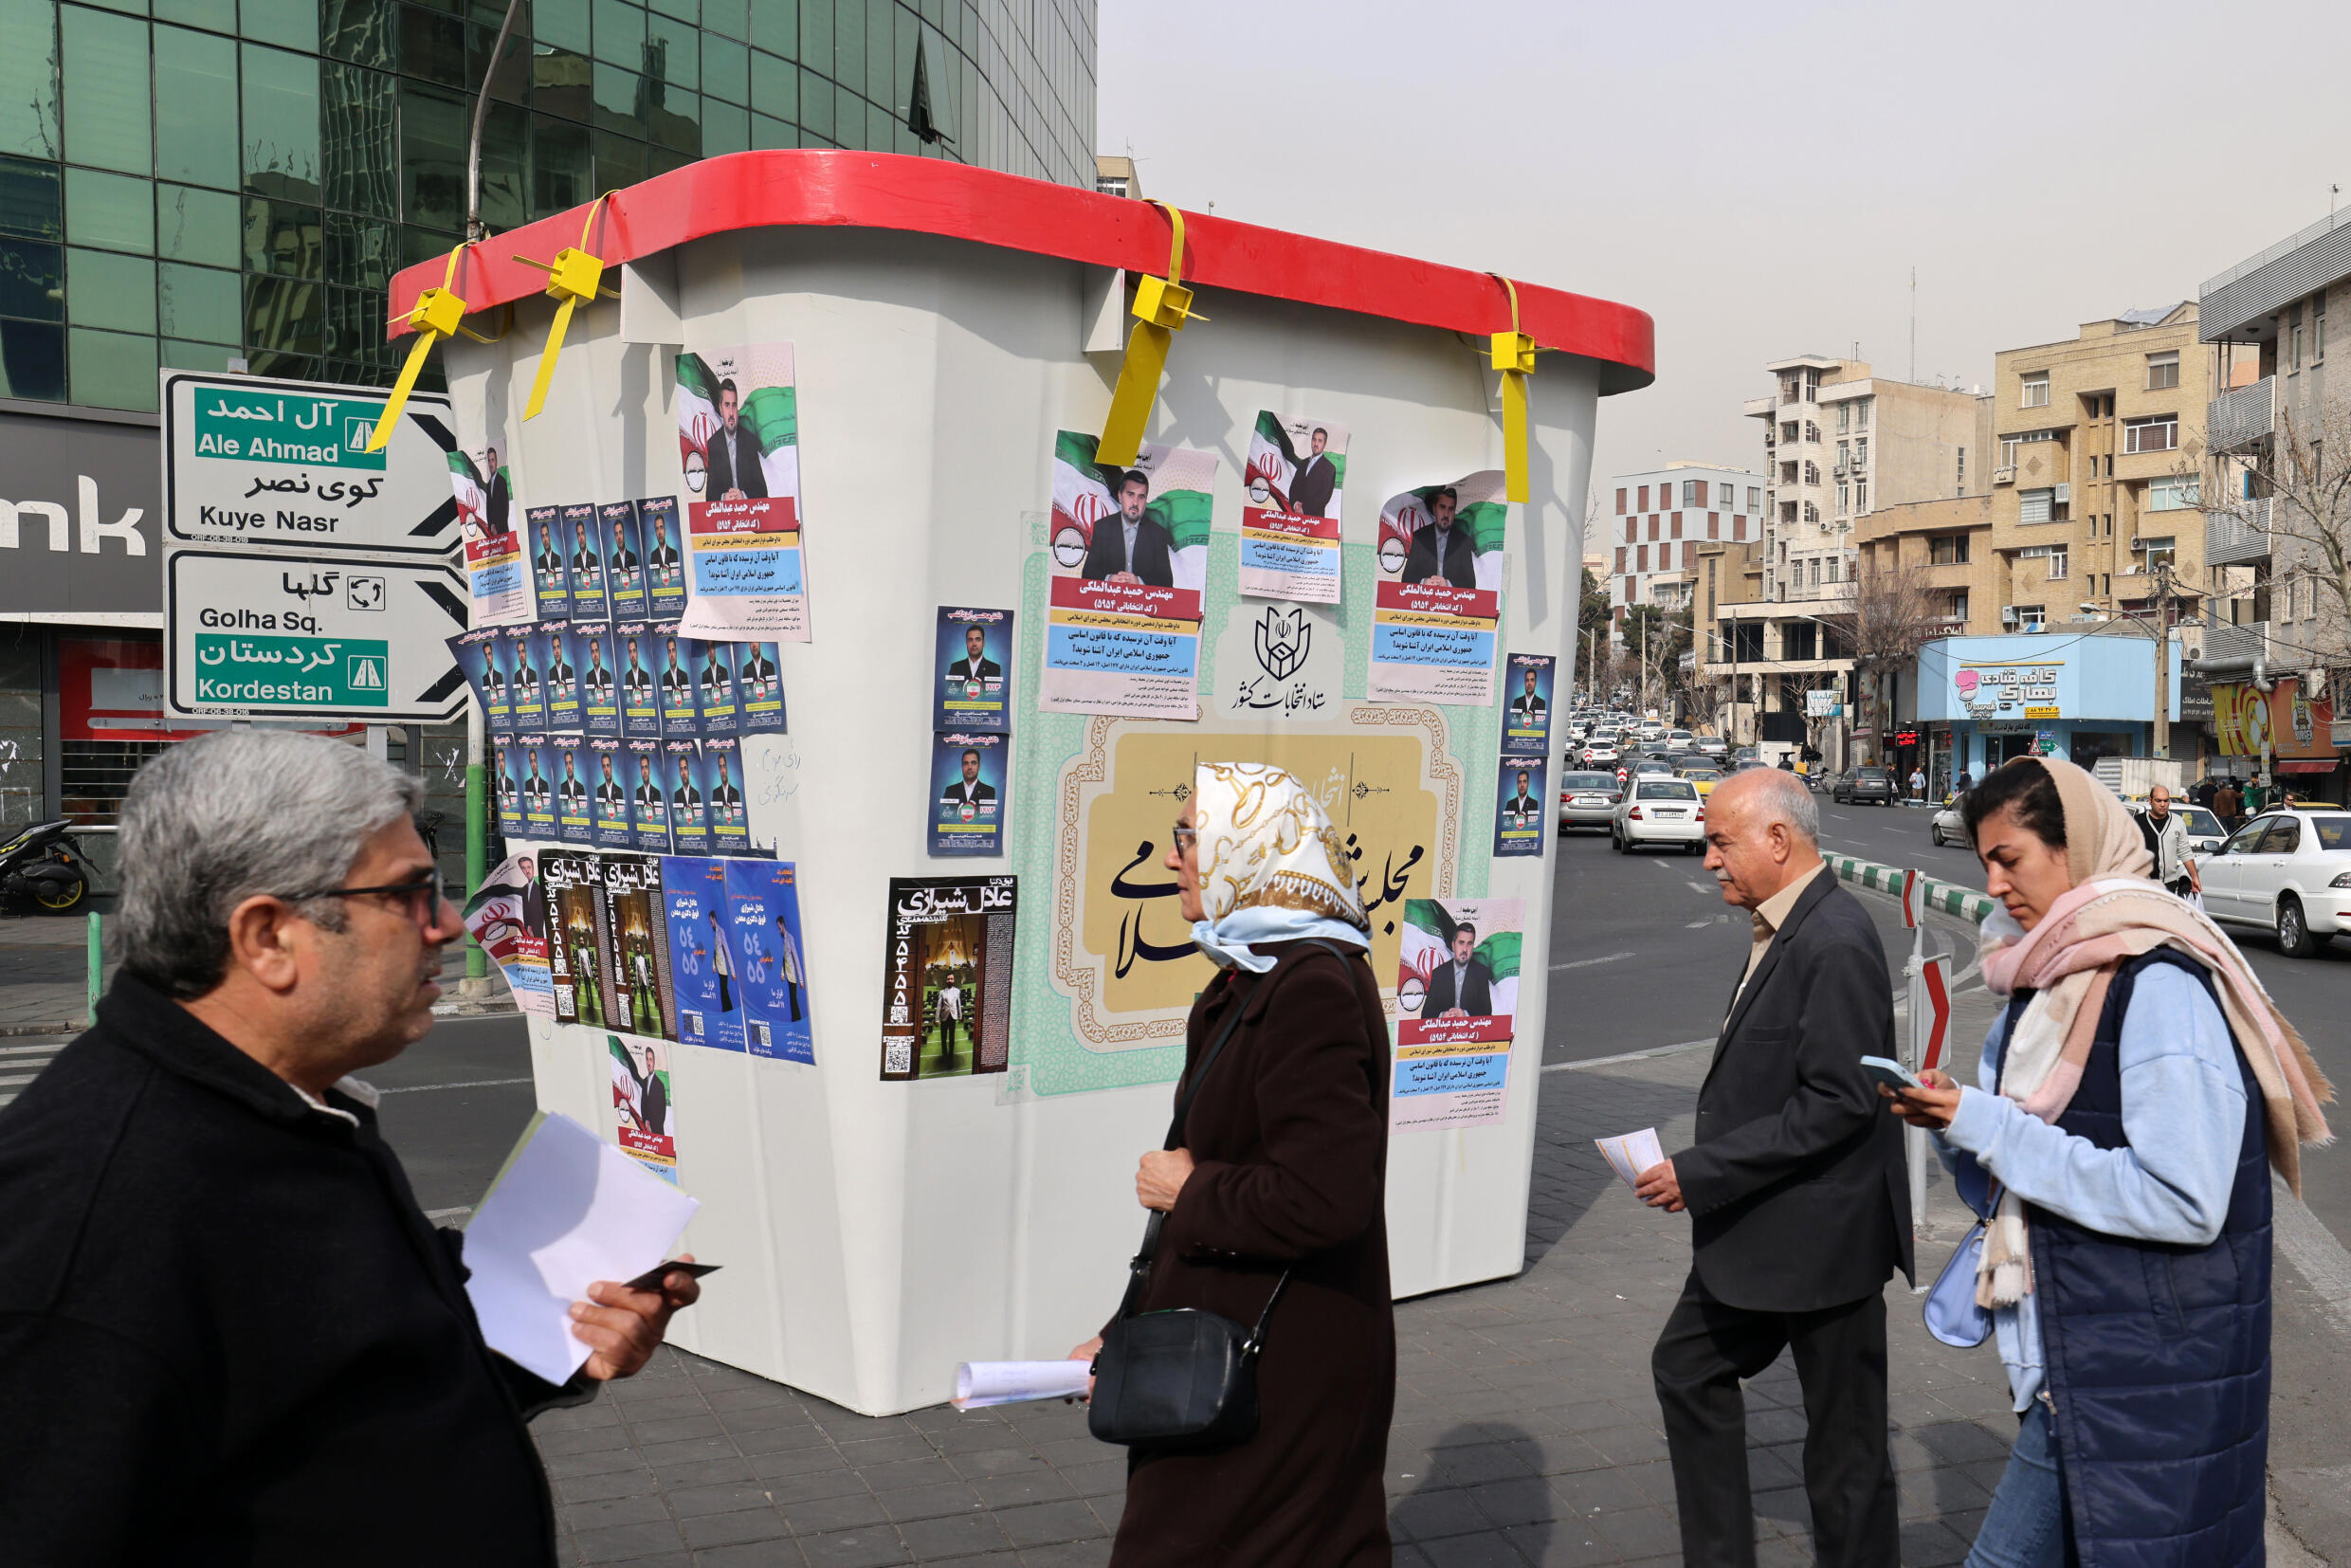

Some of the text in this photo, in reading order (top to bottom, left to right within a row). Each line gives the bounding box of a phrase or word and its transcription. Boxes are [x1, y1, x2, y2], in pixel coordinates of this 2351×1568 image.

[207, 399, 338, 429] آل احمد
[198, 433, 338, 463] Ale Ahmad
[245, 473, 384, 508] کوی نصر
[200, 505, 338, 532] Kuye Nasr
[282, 572, 339, 601] گلها
[1080, 581, 1174, 601] مهندس حمید عبدالملکی
[1399, 584, 1476, 601] مهندس حمید عبدالملکی
[199, 608, 322, 635] Golha Sq.
[1068, 629, 1088, 640] اساسی
[1089, 630, 1106, 642] قانون
[199, 640, 341, 673] کردستان
[1106, 647, 1122, 657] ایران
[1123, 648, 1144, 658] اسلامی
[1146, 653, 1170, 662] جمهوری
[1980, 668, 2056, 684] کافه قنادی
[199, 679, 332, 702] Kordestan
[1230, 675, 1265, 710] کشور
[1248, 683, 1306, 718] انتخابات
[1306, 690, 1325, 709] ستاد
[1998, 684, 2056, 704] بهارک
[544, 858, 580, 883] شیرازی
[604, 863, 638, 887] شیرازی
[898, 886, 1012, 916] عادل شیرازی
[1419, 1017, 1492, 1031] مهندس حمید عبدالملکی
